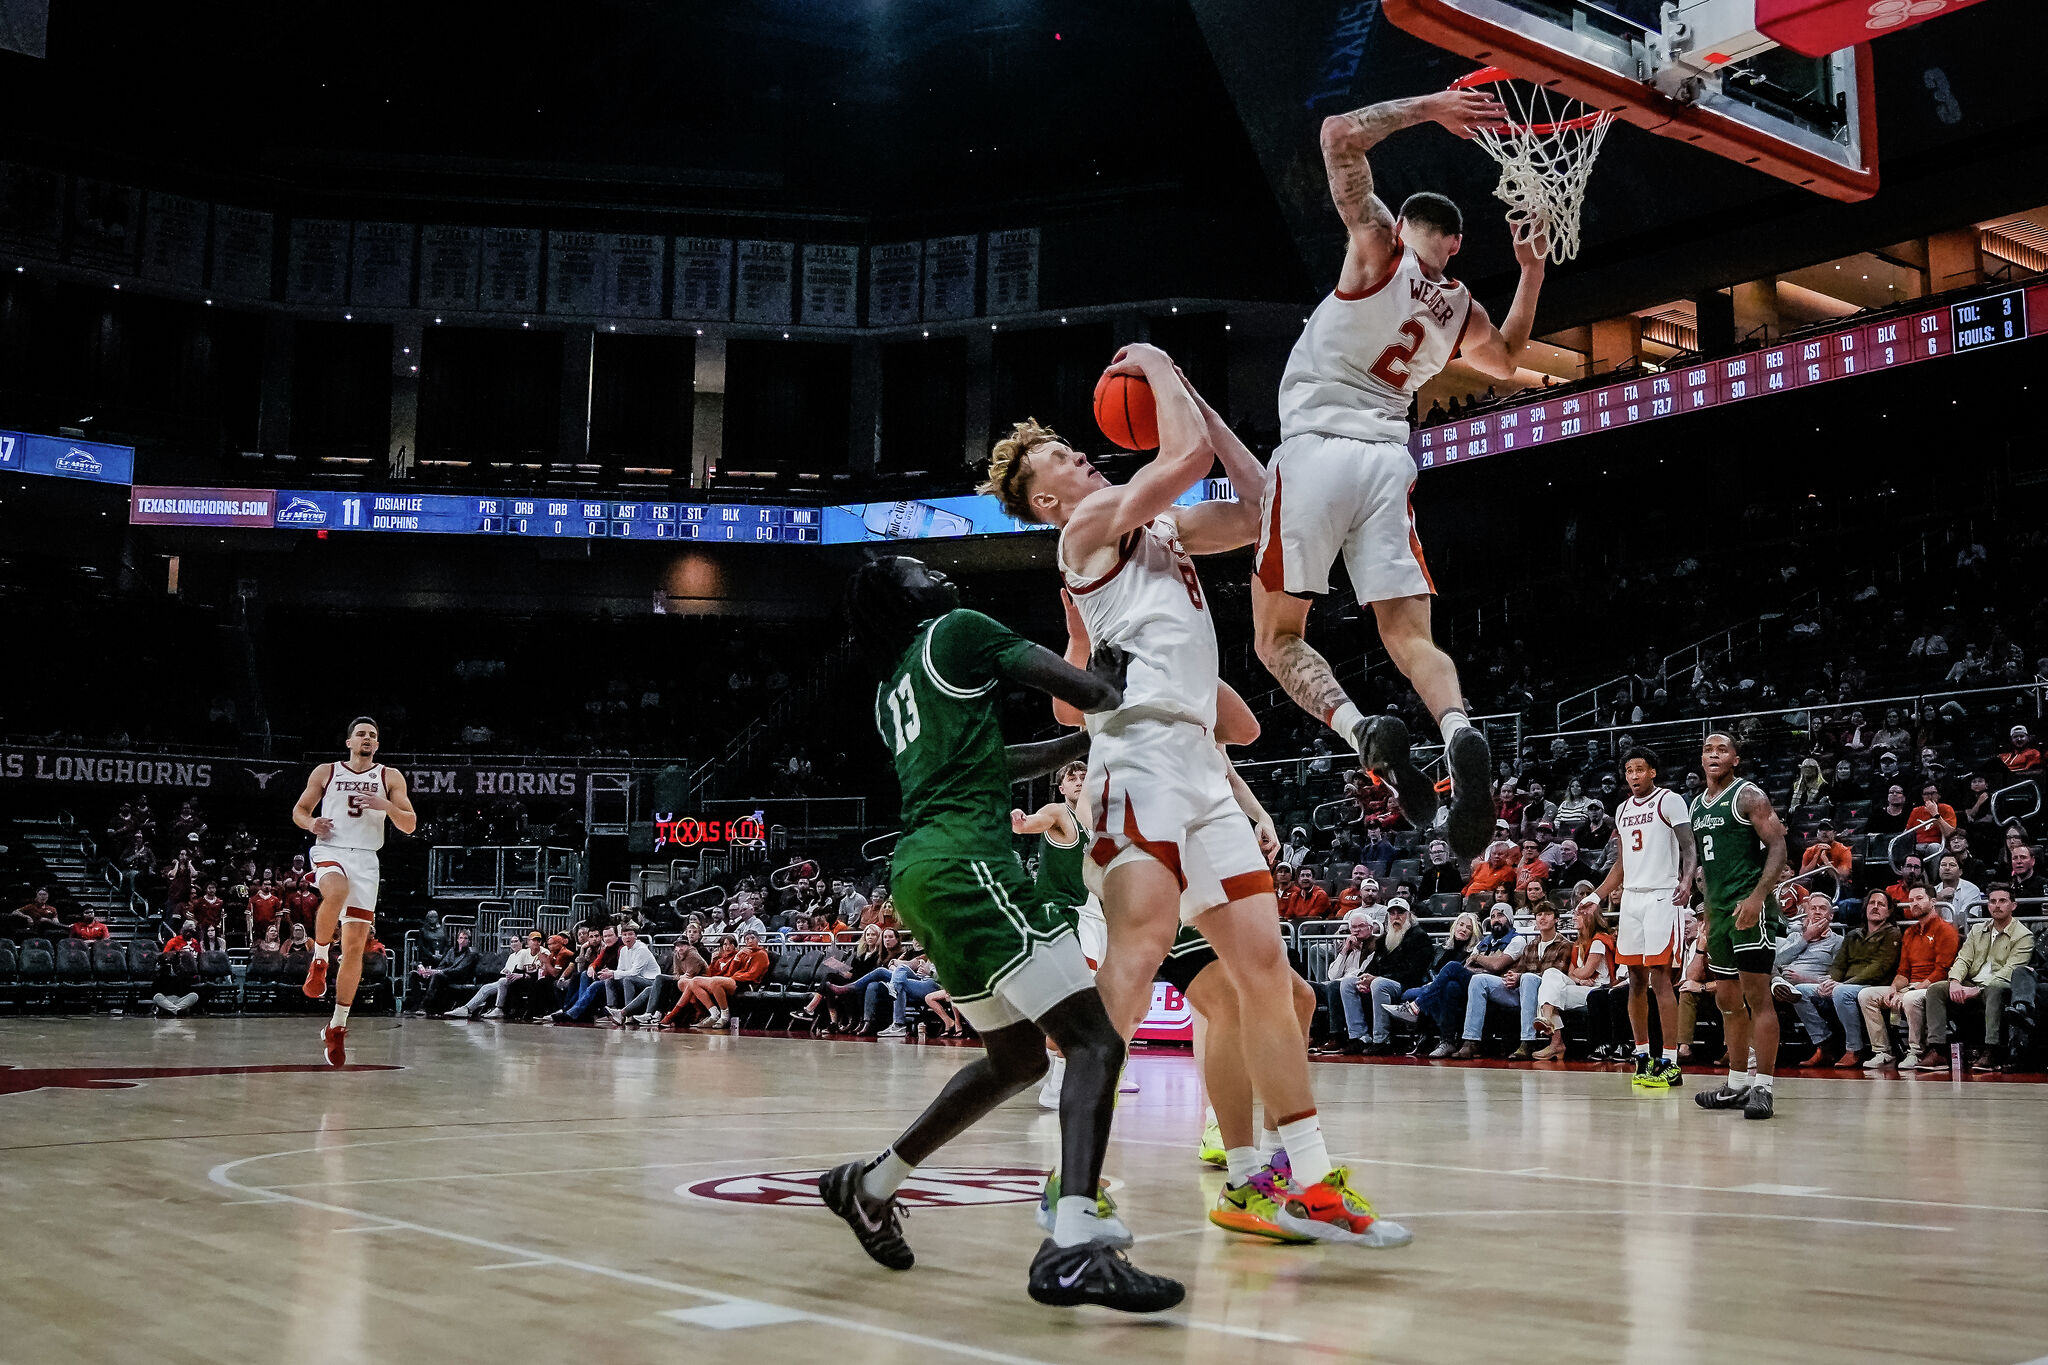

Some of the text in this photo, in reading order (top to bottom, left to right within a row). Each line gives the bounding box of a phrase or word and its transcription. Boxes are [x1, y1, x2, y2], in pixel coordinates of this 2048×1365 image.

[1923, 66, 1962, 124] 3
[1958, 298, 2012, 324] TOL: 3
[1958, 320, 2013, 348] FOULS: 8
[1368, 318, 1424, 390] 2
[1422, 315, 1939, 448] FG FGA FG% 3PM 3PA 3P% FT FTA FT% ORB DRB REB AST TO BLK STL
[1422, 451, 1434, 468] 28
[1468, 438, 1487, 456] 48.3
[1504, 432, 1514, 448] 10
[1532, 426, 1544, 442] 27
[1561, 418, 1580, 436] 37.0
[1600, 411, 1610, 428] 14
[1627, 405, 1638, 422] 19
[1652, 397, 1672, 416] 73.7
[1692, 390, 1704, 408] 14
[1732, 380, 1746, 399] 30
[1768, 372, 1784, 390] 44
[1807, 364, 1820, 382] 15
[1844, 356, 1854, 374] 11
[1886, 348, 1894, 365] 3
[1928, 338, 1937, 356] 6
[138, 499, 268, 516] TEXASLONGHORNS.COM
[342, 499, 360, 526] 11
[374, 498, 422, 512] JOSIAH LEE
[479, 501, 811, 524] PTS ORB DRB REB AST FLS STL BLK FT MIN
[373, 516, 418, 529] DOLPHINS
[484, 518, 805, 541] 0 0 0 0 0 0 0 0 0-0 0
[887, 672, 920, 756] 13
[35, 755, 212, 787] LONGHORNS
[336, 782, 379, 792] TEXAS
[476, 772, 576, 796] HORNS
[348, 795, 364, 818] 5
[656, 821, 720, 842] TEXAS
[1622, 812, 1654, 828] TEXAS
[1632, 829, 1643, 852] 3
[1702, 834, 1714, 861] 2
